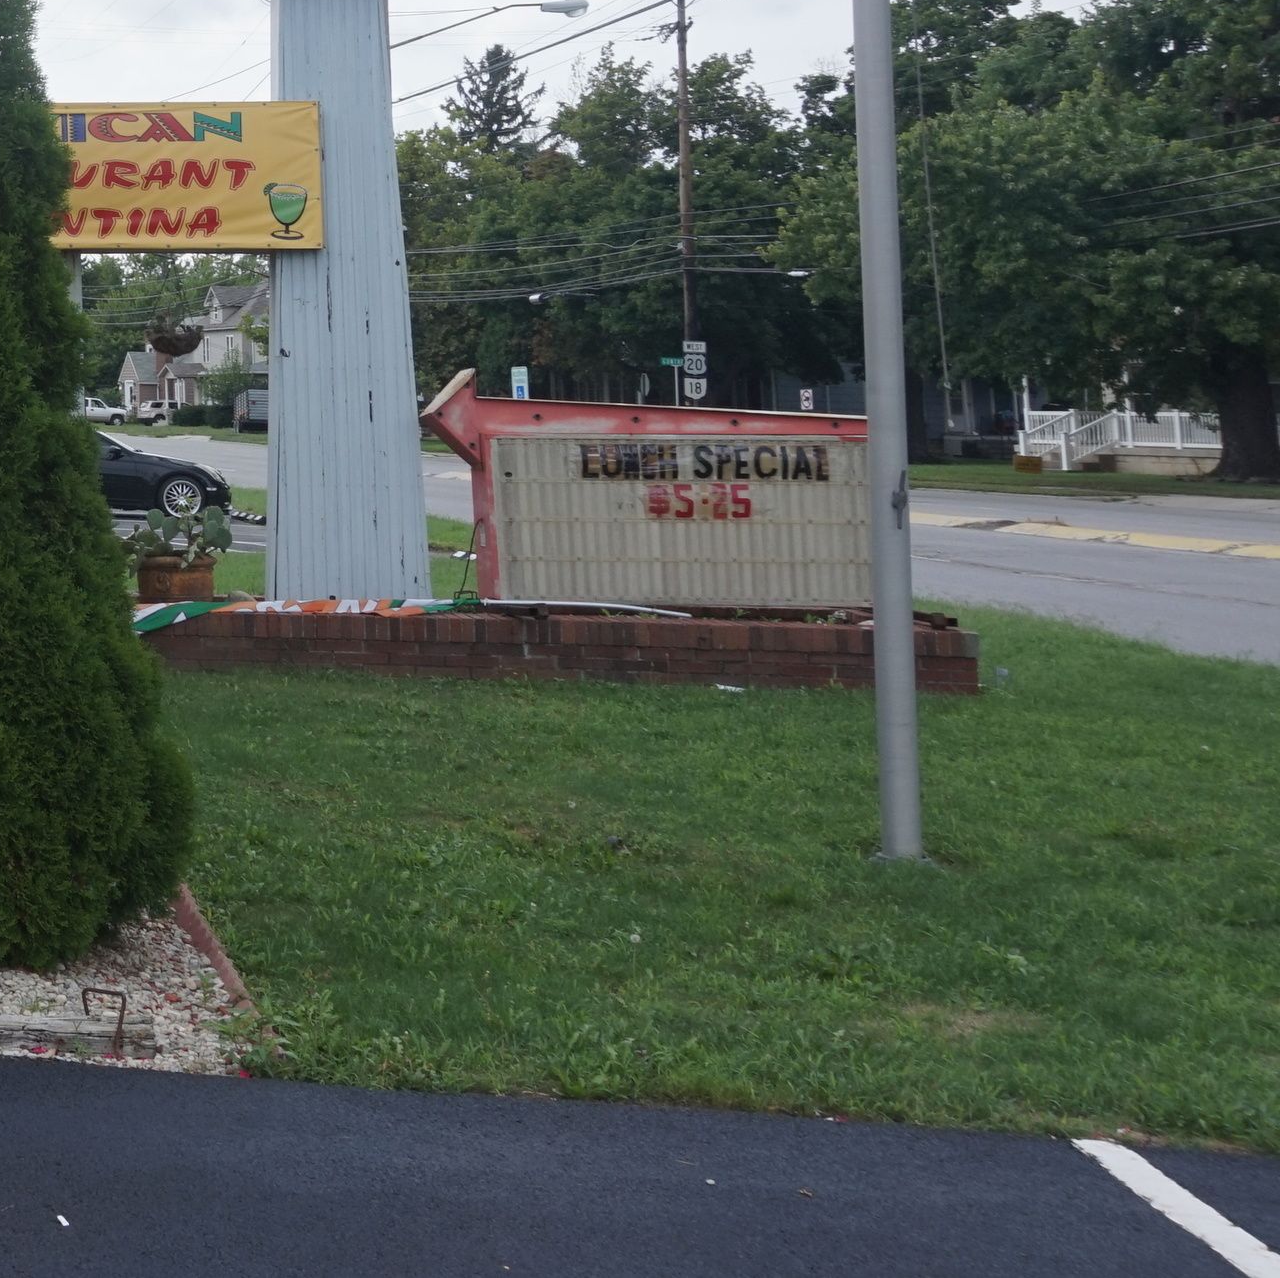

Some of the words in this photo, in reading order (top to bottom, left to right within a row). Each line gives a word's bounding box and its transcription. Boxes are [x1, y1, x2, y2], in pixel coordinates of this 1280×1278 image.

[60, 111, 243, 143] ICAN
[70, 158, 256, 190] URANT
[49, 206, 222, 238] NTINA
[686, 343, 703, 351] WEST
[686, 358, 703, 371] 20
[689, 382, 702, 395] 18
[580, 444, 679, 480] LUNCH
[693, 444, 830, 481] SPECIAL
